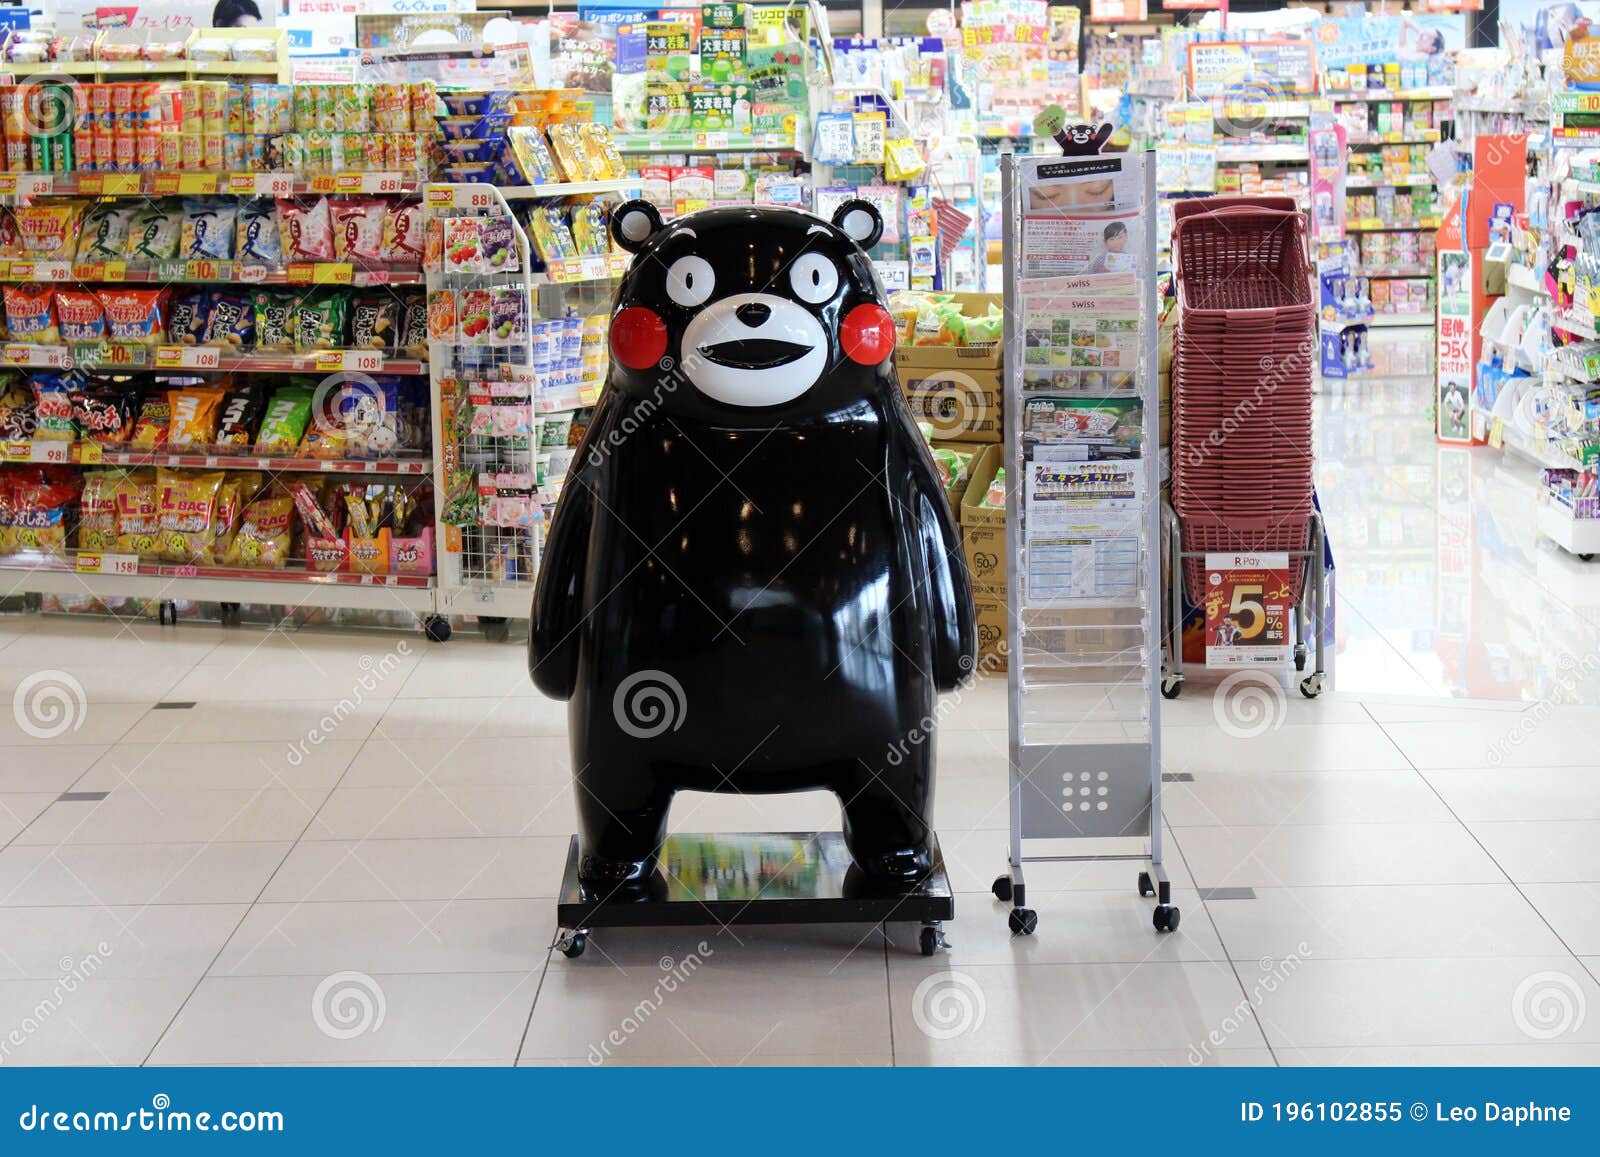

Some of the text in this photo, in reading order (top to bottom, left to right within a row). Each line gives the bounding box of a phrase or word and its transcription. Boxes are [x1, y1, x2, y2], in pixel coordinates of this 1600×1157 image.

[272, 181, 287, 191] 88
[380, 180, 395, 190] 88
[472, 195, 488, 205] 88
[51, 269, 65, 279] 98
[159, 263, 185, 275] LINE
[1066, 279, 1091, 289] swiss
[1072, 300, 1096, 308] swiss
[1441, 341, 1469, 359] つらく
[196, 354, 214, 364] 108
[358, 358, 376, 368] 108
[47, 450, 61, 460] 98
[1046, 473, 1126, 483] スタンプラリー
[178, 501, 207, 512] BAG
[115, 562, 133, 572] 158
[1243, 557, 1260, 567] Pay
[1229, 584, 1283, 639] 5 %
